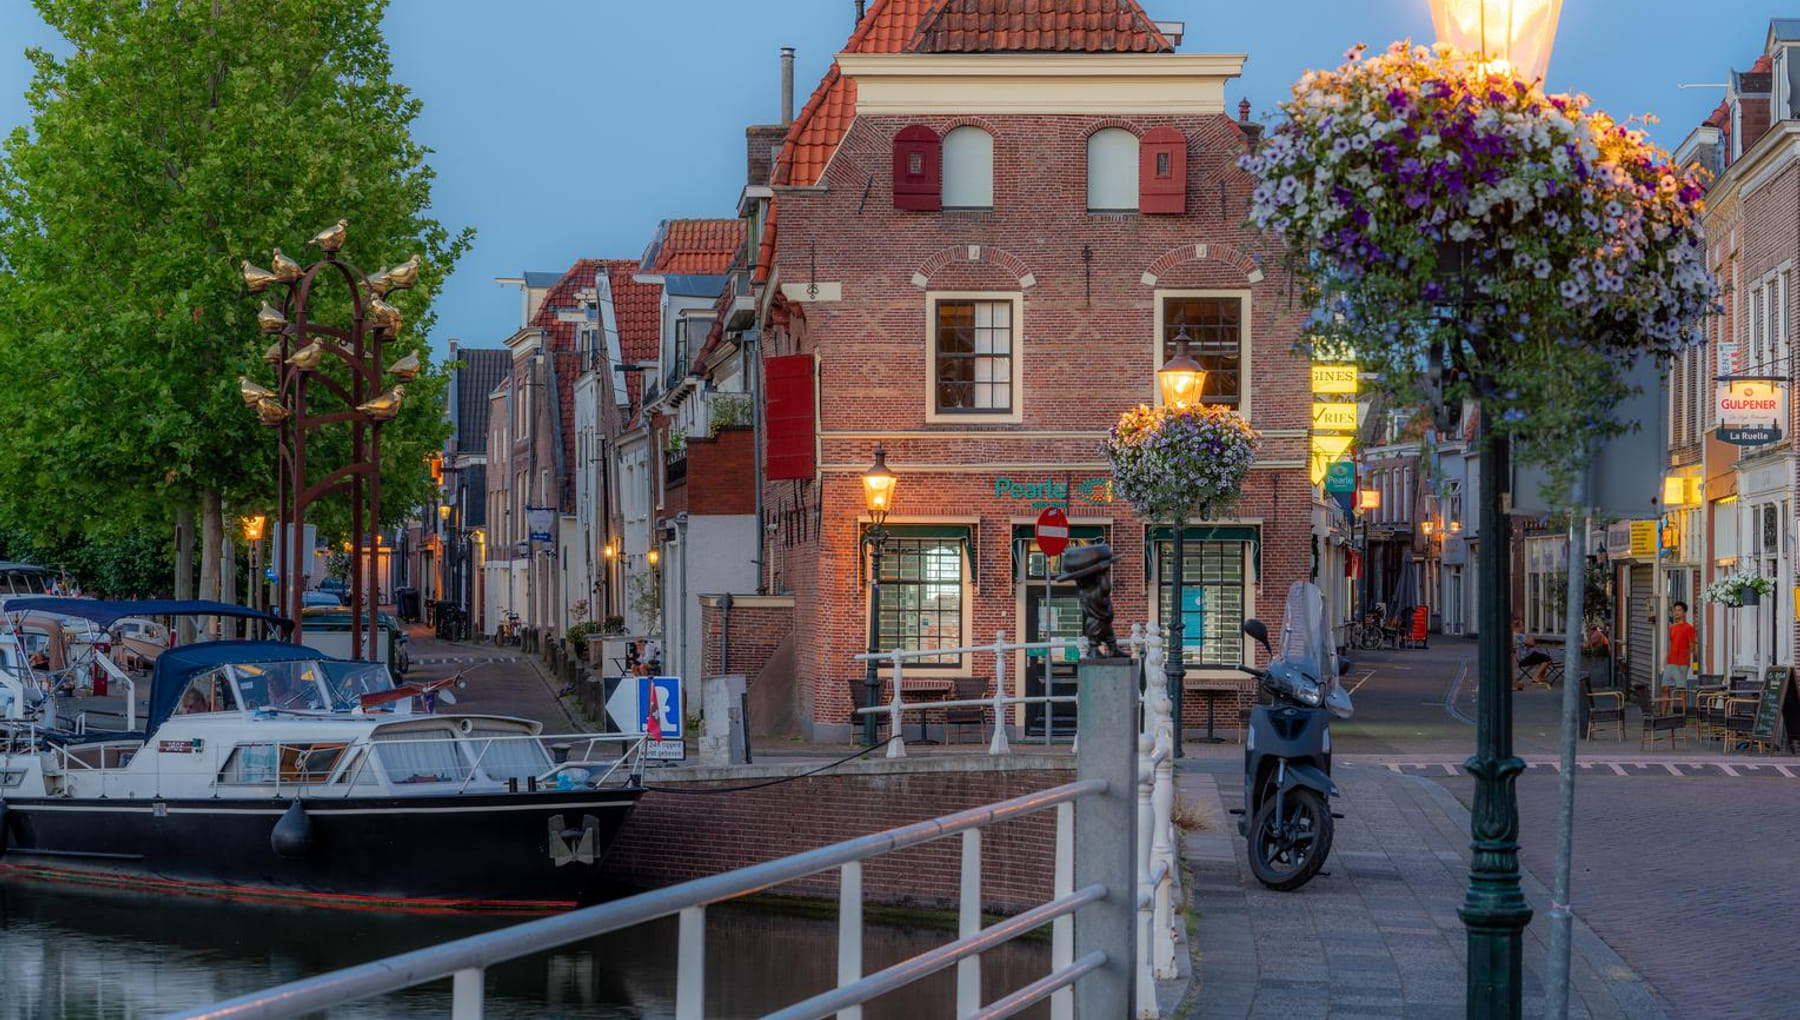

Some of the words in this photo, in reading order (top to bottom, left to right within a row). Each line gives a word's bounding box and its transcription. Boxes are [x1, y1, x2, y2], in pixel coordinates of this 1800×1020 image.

[1721, 399, 1776, 409] GULPENER
[1730, 432, 1739, 440] La
[1742, 432, 1768, 440] Ruelle
[1327, 475, 1354, 485] Pearle
[995, 478, 1068, 499] Pearle
